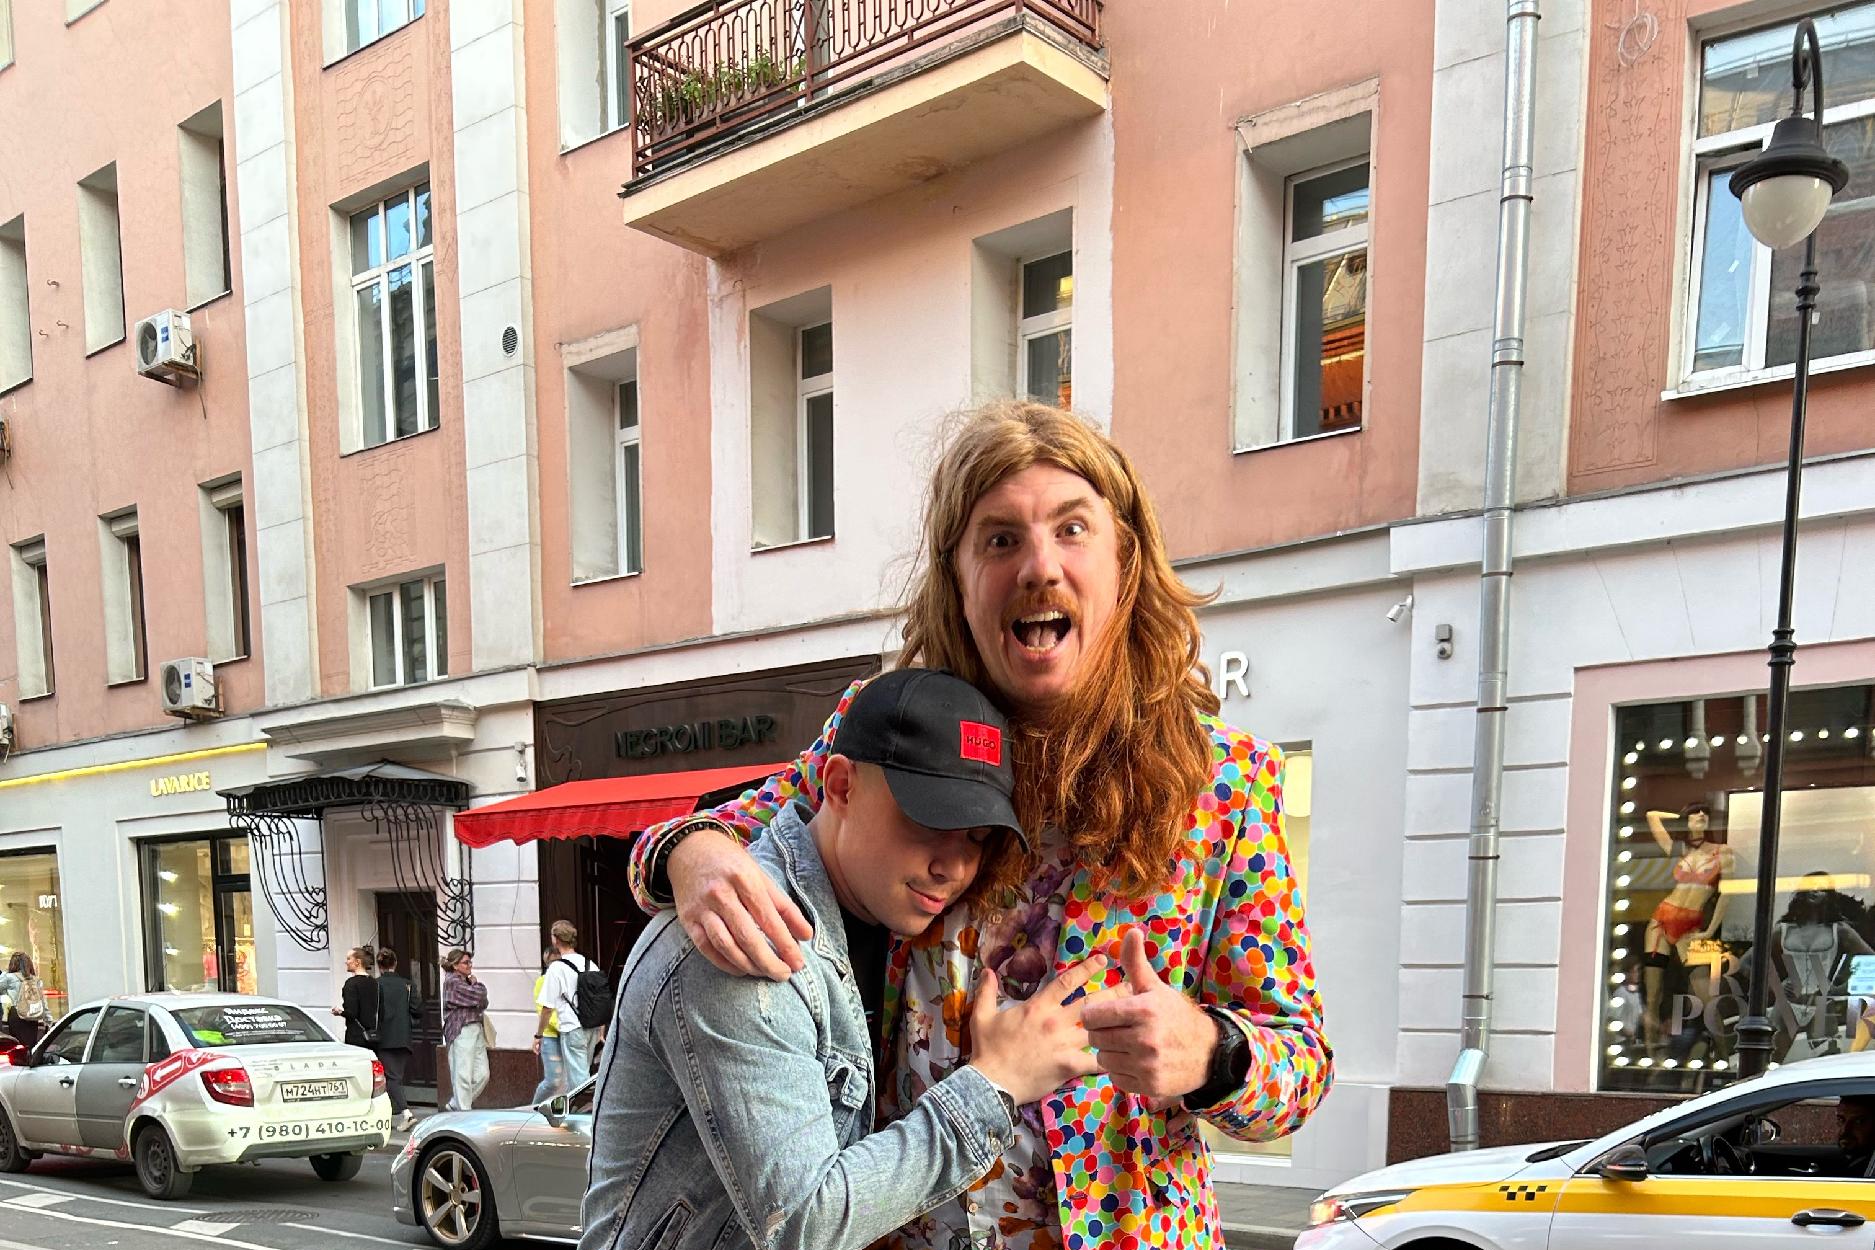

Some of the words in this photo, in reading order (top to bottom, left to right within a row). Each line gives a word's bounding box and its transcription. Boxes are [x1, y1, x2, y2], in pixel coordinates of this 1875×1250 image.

[615, 722, 713, 760] NEGRONI
[717, 713, 777, 750] BAR
[966, 735, 996, 750] HUGO
[150, 771, 211, 797] LAVARICE
[290, 1061, 338, 1071] LADA
[227, 1126, 251, 1139] +7
[258, 1123, 310, 1141] (980)
